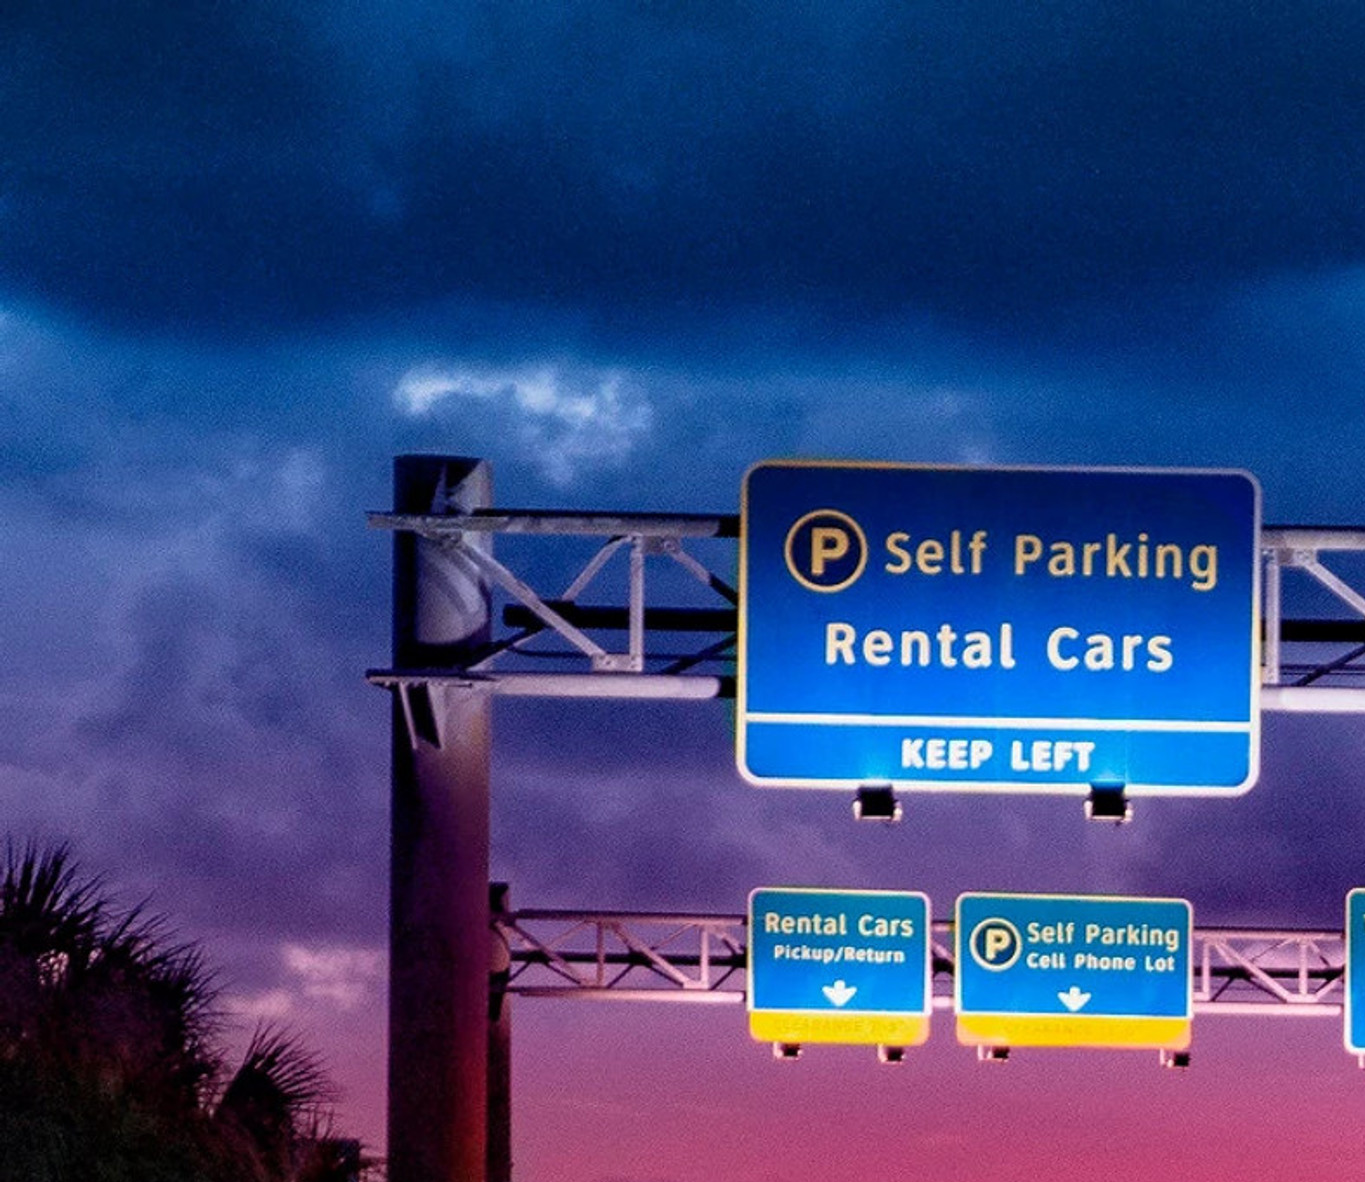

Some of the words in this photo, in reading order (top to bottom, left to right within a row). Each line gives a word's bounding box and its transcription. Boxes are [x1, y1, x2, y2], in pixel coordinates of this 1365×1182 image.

[885, 530, 987, 575] Self
[1014, 534, 1219, 591] Parking
[825, 623, 1015, 668] Rental
[1047, 627, 1173, 672] Cars
[901, 738, 993, 771] KEEP
[1011, 740, 1095, 772] LEFT
[765, 912, 848, 936] Rental
[858, 914, 914, 937] Cars
[1027, 922, 1075, 945] Self
[1085, 924, 1179, 952] Parking
[774, 944, 905, 965] Pickup/Return
[1026, 952, 1066, 969] Cell
[1074, 954, 1135, 971] Phone
[1144, 956, 1175, 972] Lot
